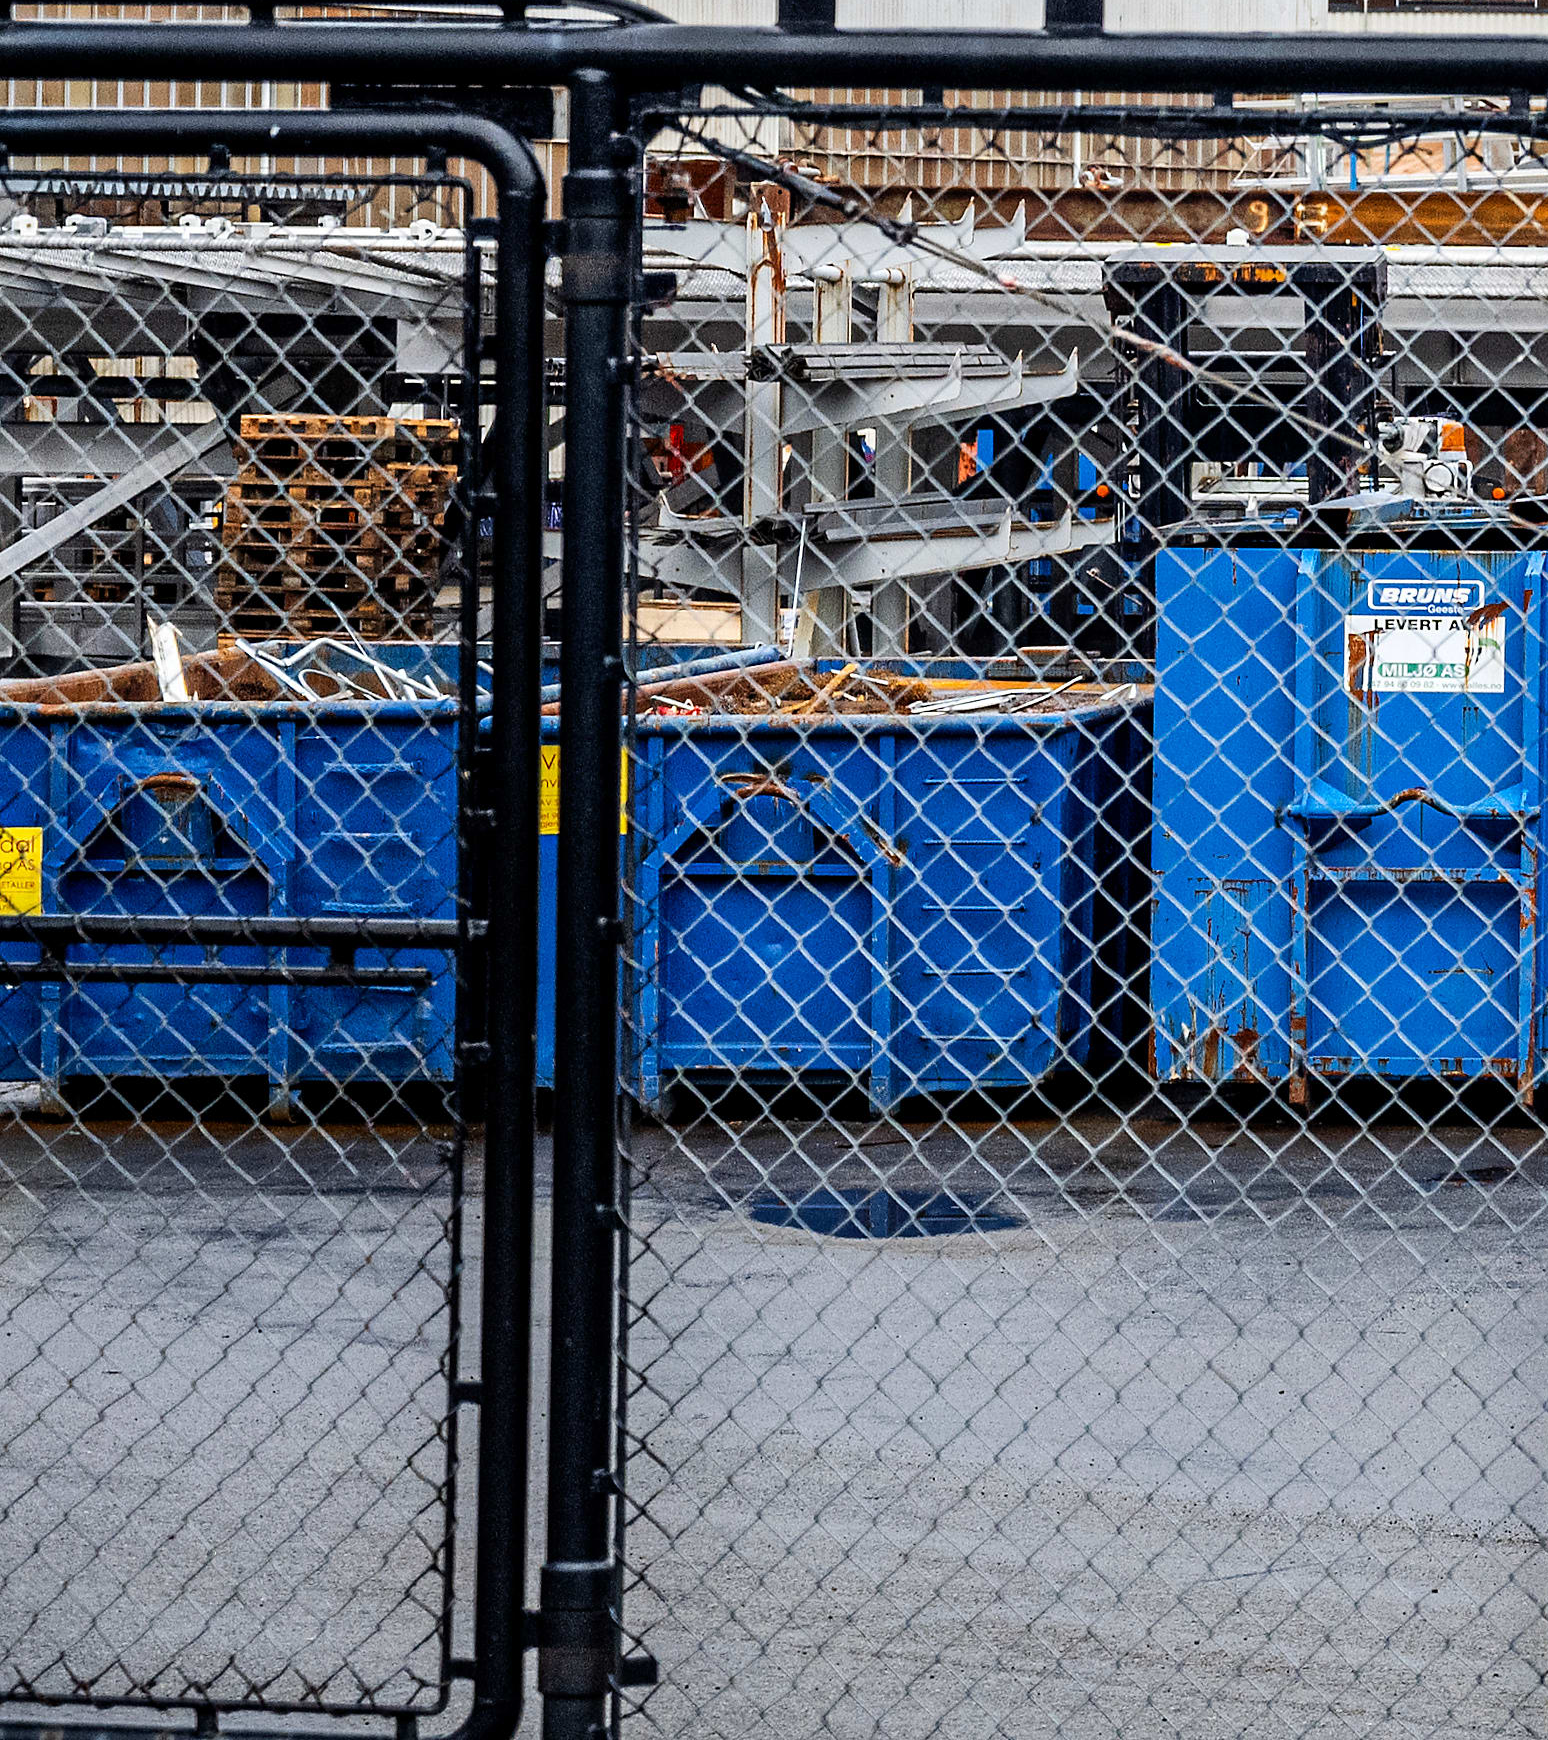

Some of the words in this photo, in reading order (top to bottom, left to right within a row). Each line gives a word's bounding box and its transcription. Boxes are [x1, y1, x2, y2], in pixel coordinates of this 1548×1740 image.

[1380, 587, 1472, 604] BRUNS
[1374, 619, 1443, 631] LEVERT
[1381, 663, 1438, 678] MILJØ
[1440, 663, 1467, 678] AS
